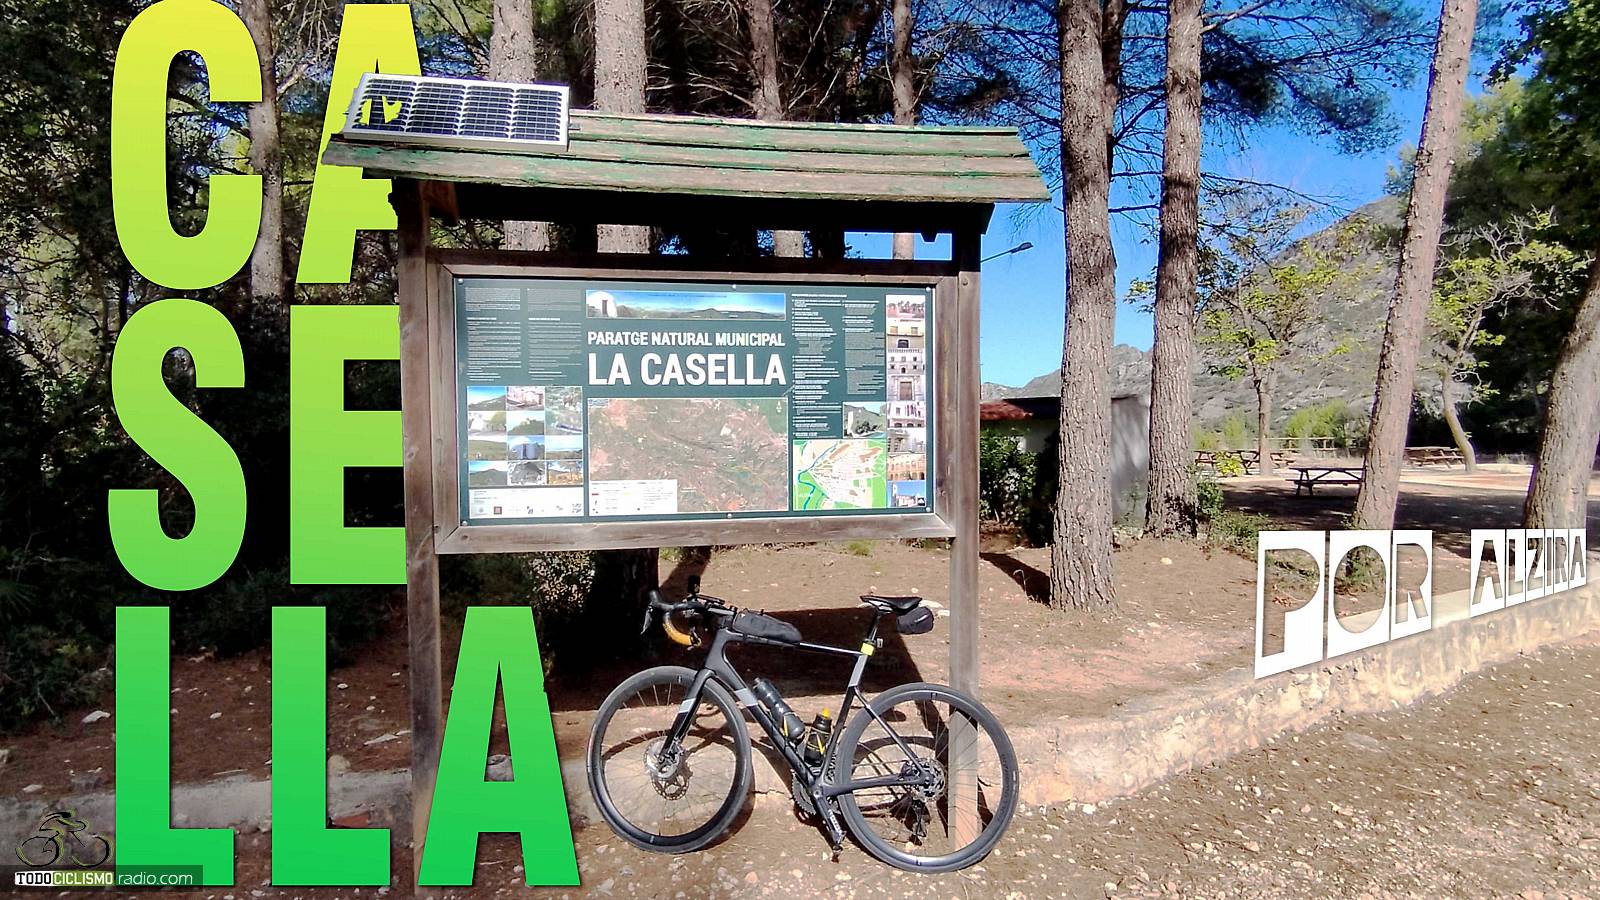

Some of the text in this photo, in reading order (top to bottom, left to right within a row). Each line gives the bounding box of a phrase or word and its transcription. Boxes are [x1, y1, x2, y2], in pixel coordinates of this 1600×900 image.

[587, 331, 786, 347] PARATGE NATURAL MUNICIPAL
[588, 352, 787, 386] LA CASELLA
